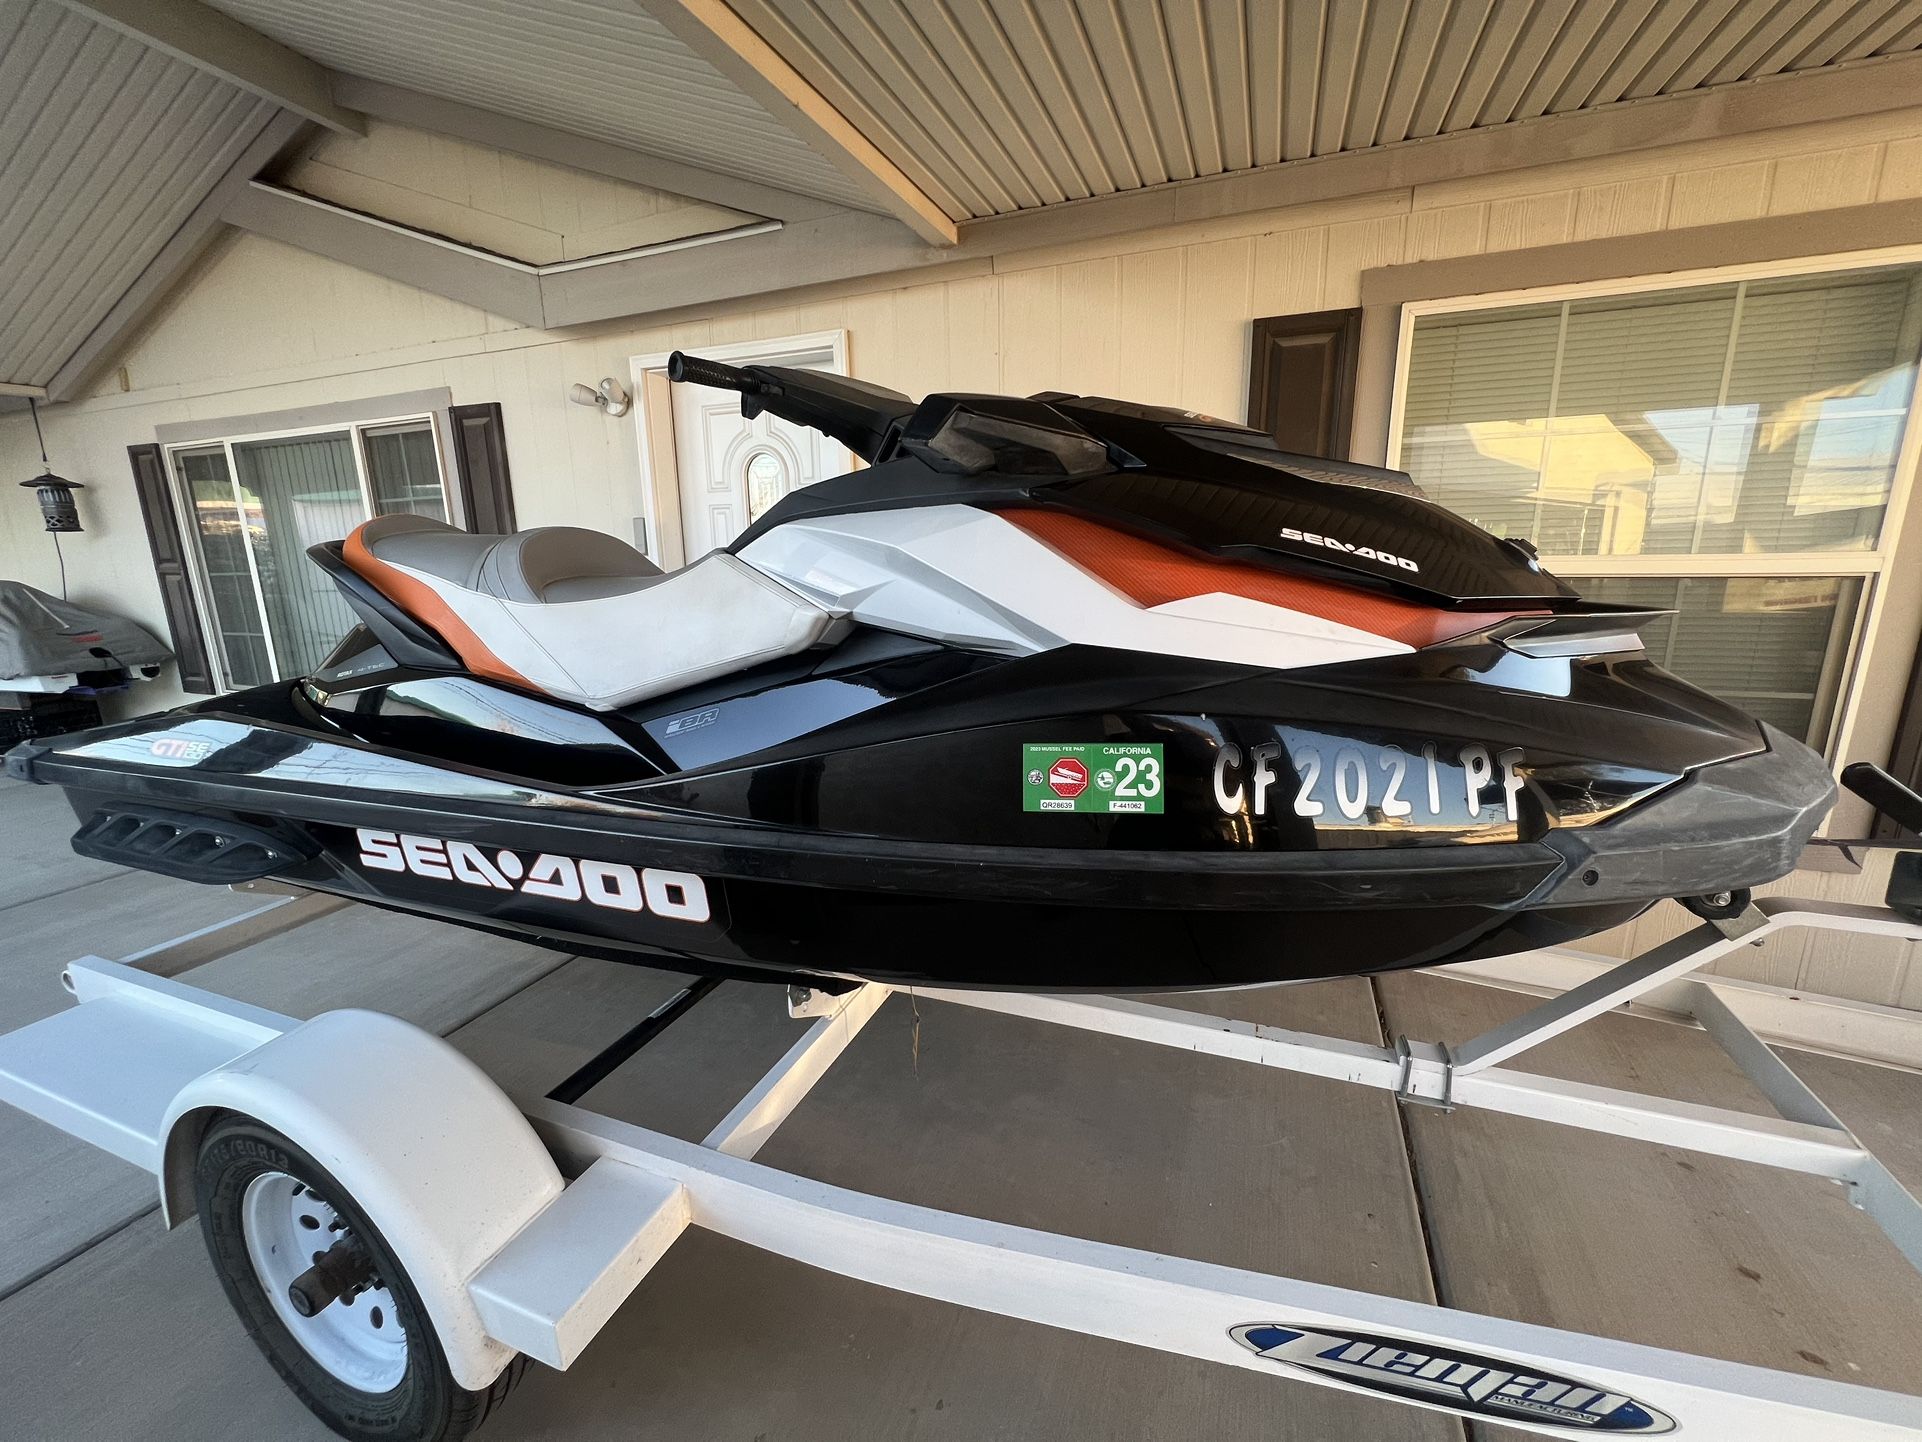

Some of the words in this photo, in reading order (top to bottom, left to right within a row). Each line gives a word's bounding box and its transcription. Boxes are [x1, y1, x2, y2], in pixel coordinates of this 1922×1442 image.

[1103, 747, 1152, 755] CALIFORNIA
[1114, 757, 1161, 797] 23
[1214, 743, 1281, 816] CF
[1293, 742, 1441, 820] 2021
[1459, 743, 1525, 822] PF
